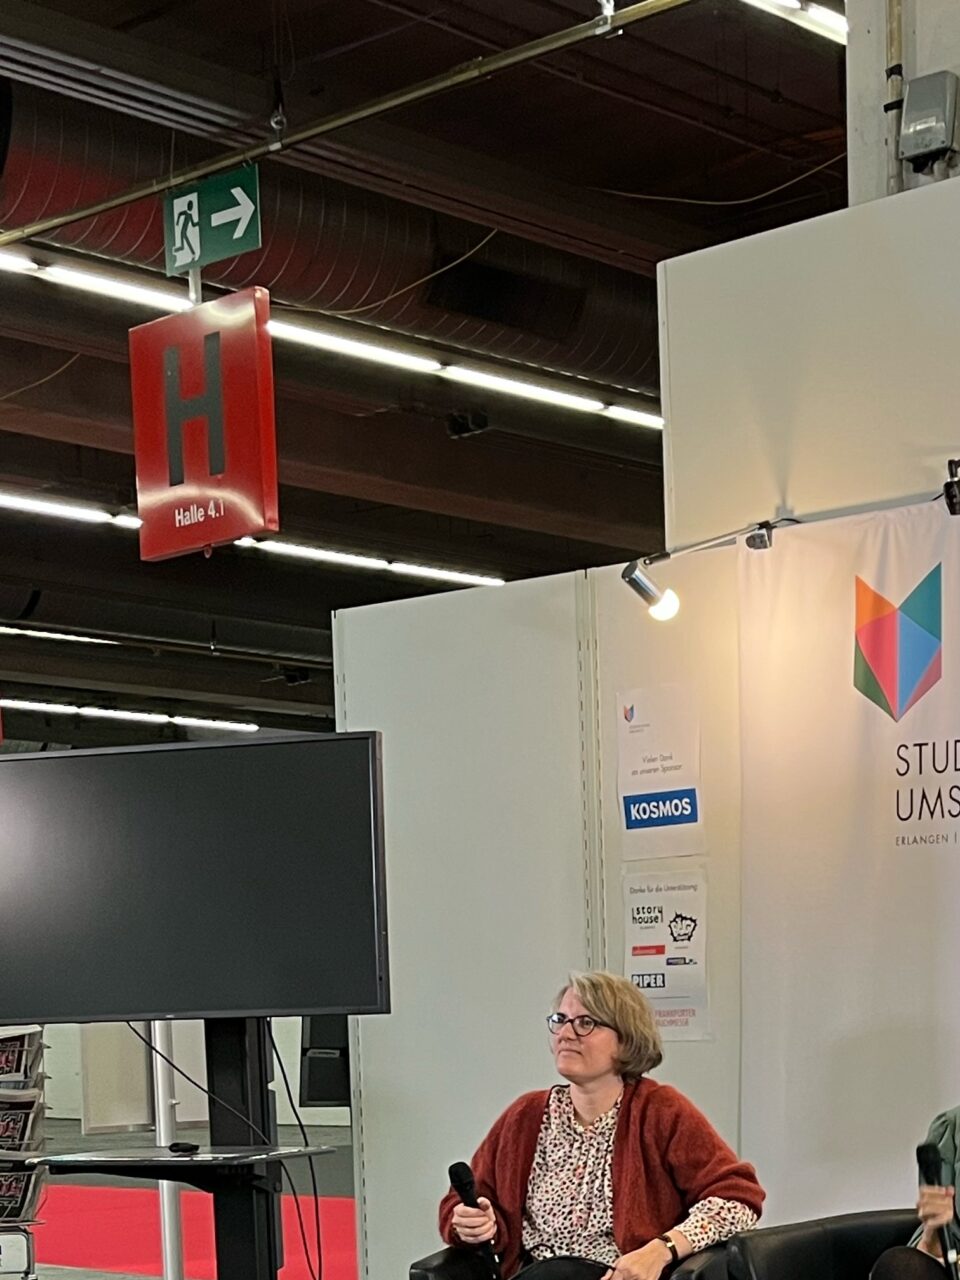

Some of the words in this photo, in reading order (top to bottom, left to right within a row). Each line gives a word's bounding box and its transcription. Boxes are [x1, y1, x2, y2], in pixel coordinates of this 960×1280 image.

[163, 331, 225, 487] H
[175, 504, 205, 528] Halle
[208, 499, 225, 518] 4.1
[630, 797, 692, 820] KOSMOS
[895, 833, 949, 847] ERLANGEN
[632, 908, 659, 924] house
[632, 975, 664, 988] PIPER
